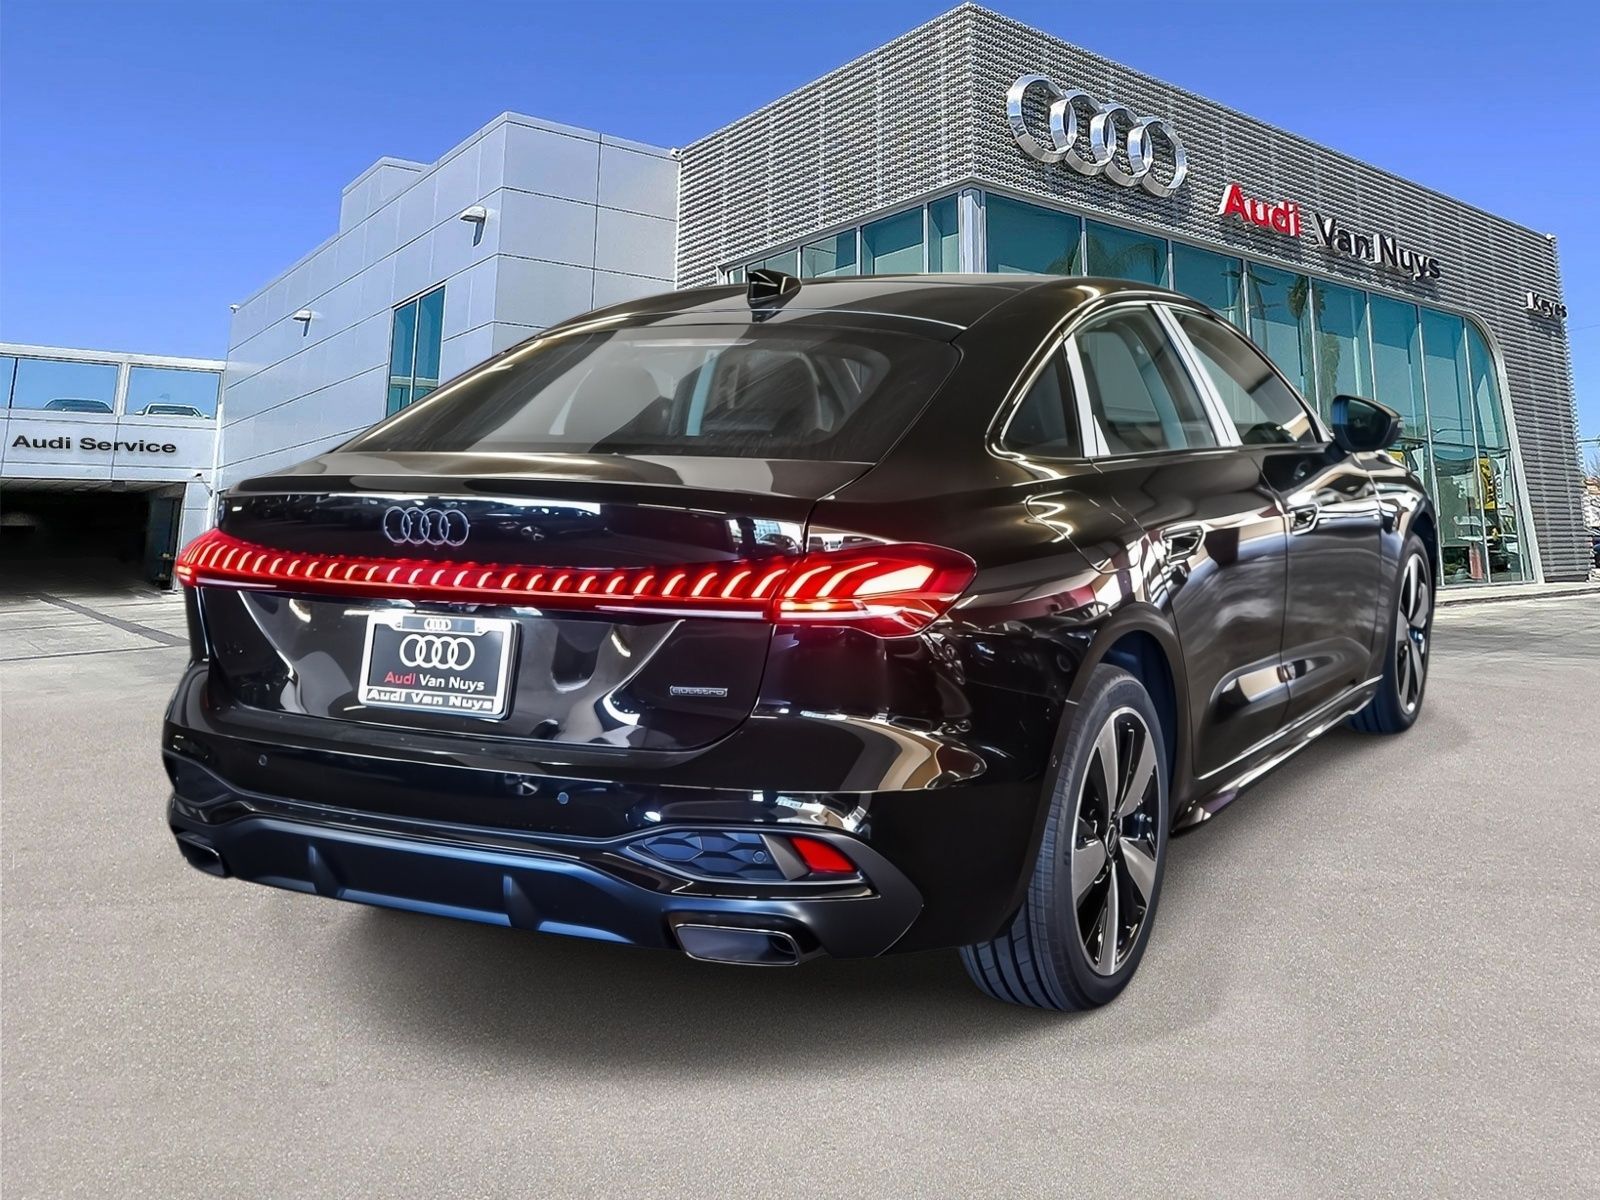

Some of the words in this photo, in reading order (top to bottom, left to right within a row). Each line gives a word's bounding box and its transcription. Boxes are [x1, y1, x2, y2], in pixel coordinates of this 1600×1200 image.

[1216, 182, 1301, 237] Audi
[1310, 212, 1369, 260] Van
[1373, 233, 1441, 280] Nuys
[12, 435, 71, 449] Audi
[79, 437, 177, 453] Service
[384, 671, 416, 685] Audi
[419, 673, 445, 688] Van
[448, 676, 485, 693] Nuys
[366, 689, 405, 702] Audi
[411, 692, 443, 705] Van
[448, 695, 493, 711] Nuys
